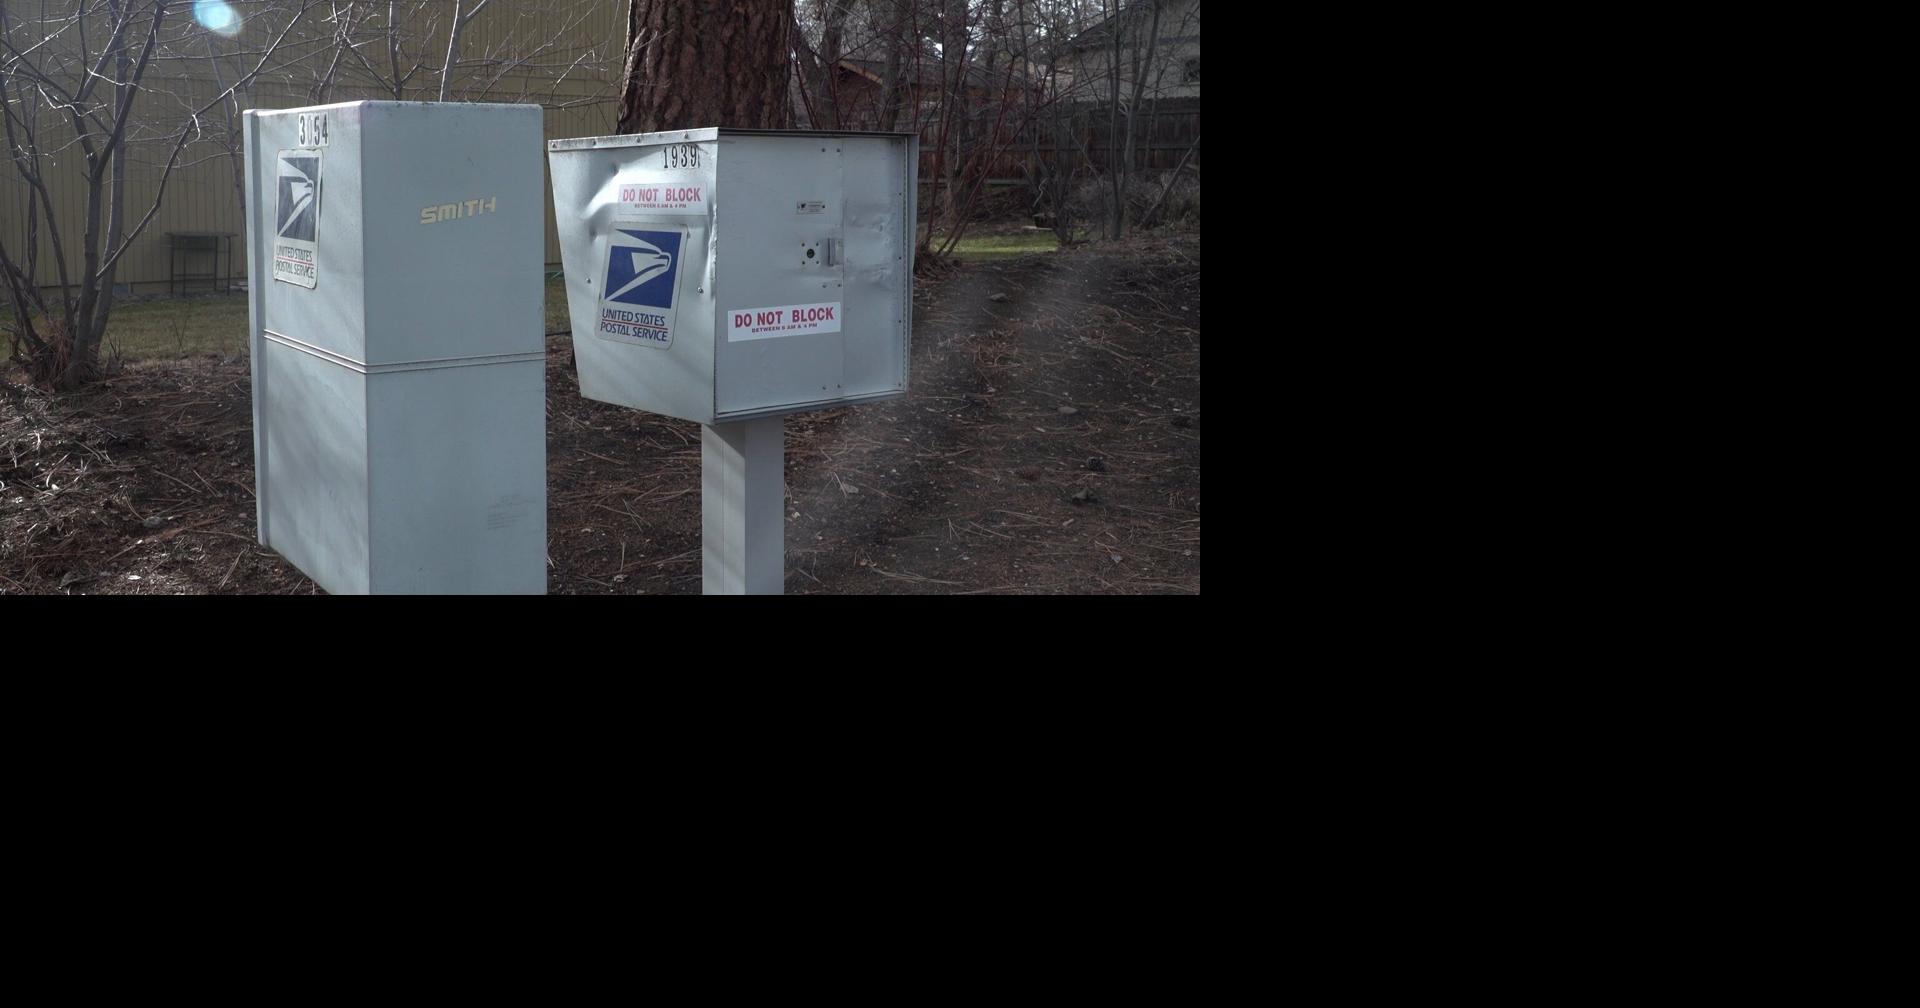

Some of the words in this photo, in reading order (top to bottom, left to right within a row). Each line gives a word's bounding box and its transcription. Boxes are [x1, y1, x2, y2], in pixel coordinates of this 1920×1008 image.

[300, 114, 328, 146] 3054
[663, 144, 697, 169] 1939
[623, 188, 636, 202] DO
[639, 188, 659, 202] NOT
[665, 187, 701, 202] BLOCK
[420, 196, 497, 225] SMITH
[276, 245, 294, 258] UNITED
[294, 248, 313, 262] STATES
[275, 259, 293, 274] POSTAL
[293, 263, 315, 279] SERVICE
[602, 308, 634, 322] UNITED
[634, 312, 666, 327] STATES
[735, 313, 752, 328] DO
[757, 311, 783, 326] NOT
[792, 307, 834, 323] BLOCK
[600, 322, 631, 336] POSTAL
[632, 326, 669, 342] SERVICE
